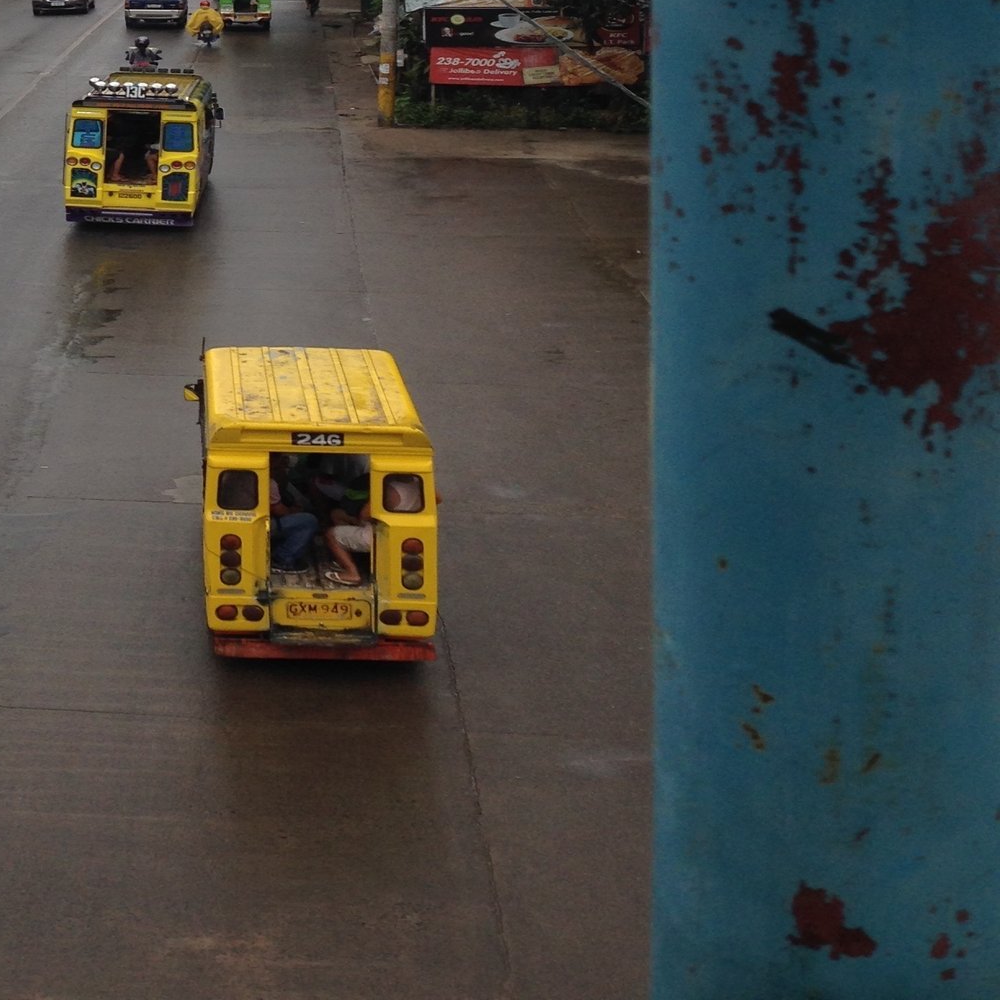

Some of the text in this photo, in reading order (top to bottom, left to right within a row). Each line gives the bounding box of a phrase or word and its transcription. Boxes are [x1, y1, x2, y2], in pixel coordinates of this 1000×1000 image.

[436, 56, 496, 67] 238-7000
[126, 86, 146, 98] 13C
[296, 433, 342, 446] 24G
[289, 602, 349, 615] GXM 949
